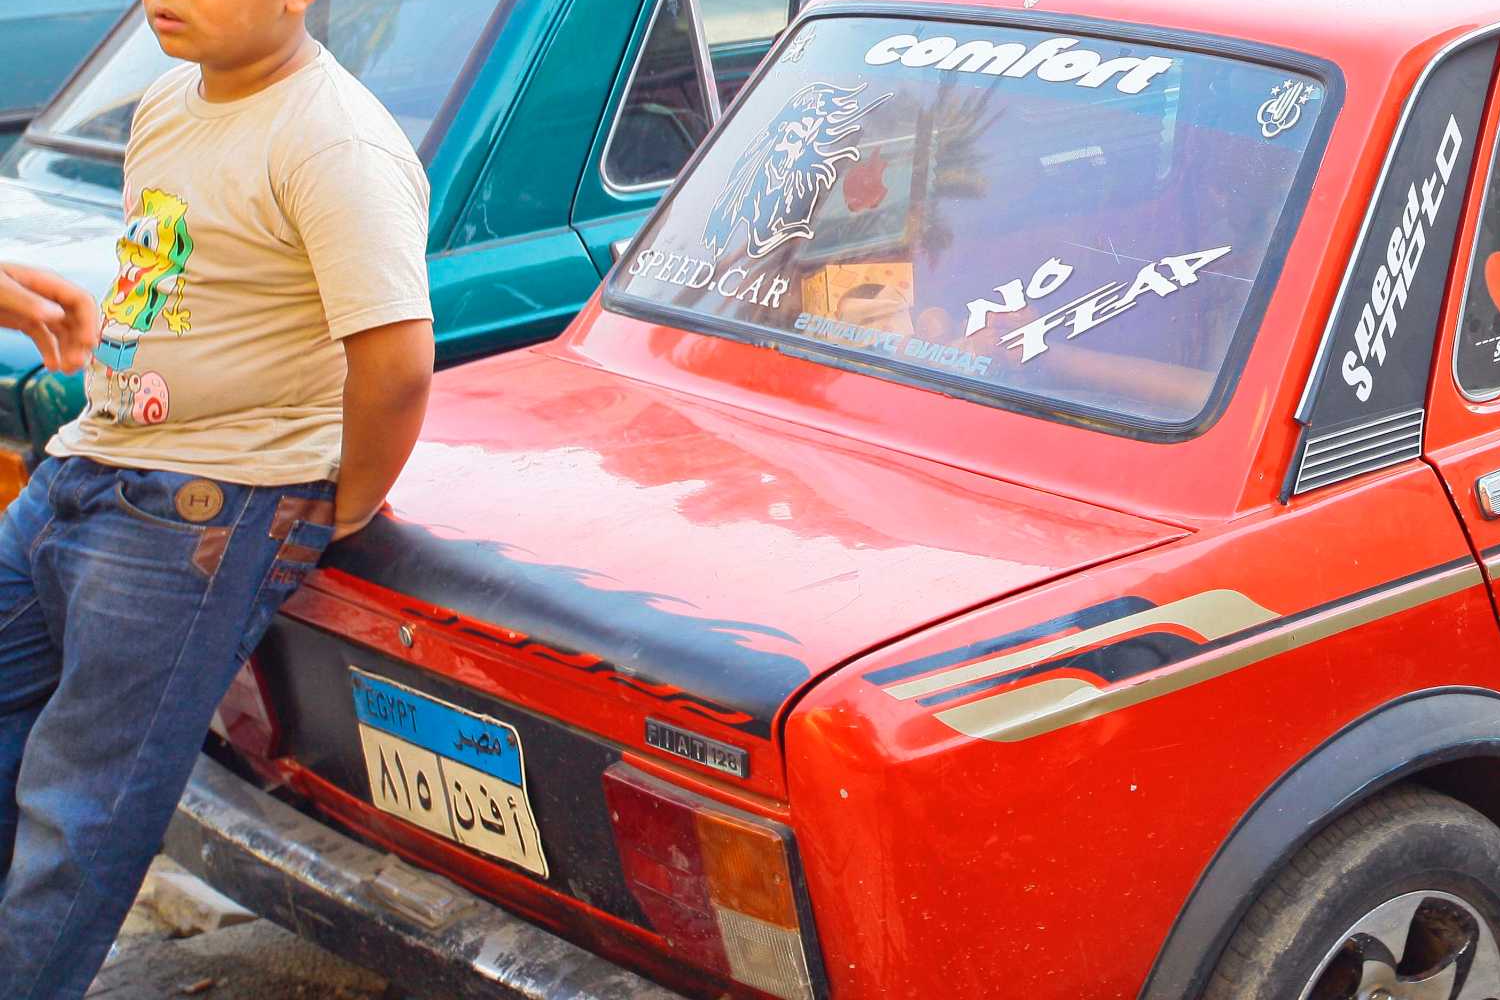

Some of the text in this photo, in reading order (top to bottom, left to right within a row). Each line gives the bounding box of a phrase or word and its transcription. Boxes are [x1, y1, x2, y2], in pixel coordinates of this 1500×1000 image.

[864, 34, 1174, 94] comfort
[965, 256, 1074, 337] NO
[1341, 181, 1422, 402] speed
[365, 693, 418, 733] EGYPT
[453, 730, 503, 755] مصر
[378, 744, 432, 811] ٨١٥
[647, 725, 741, 772] FIAT 128
